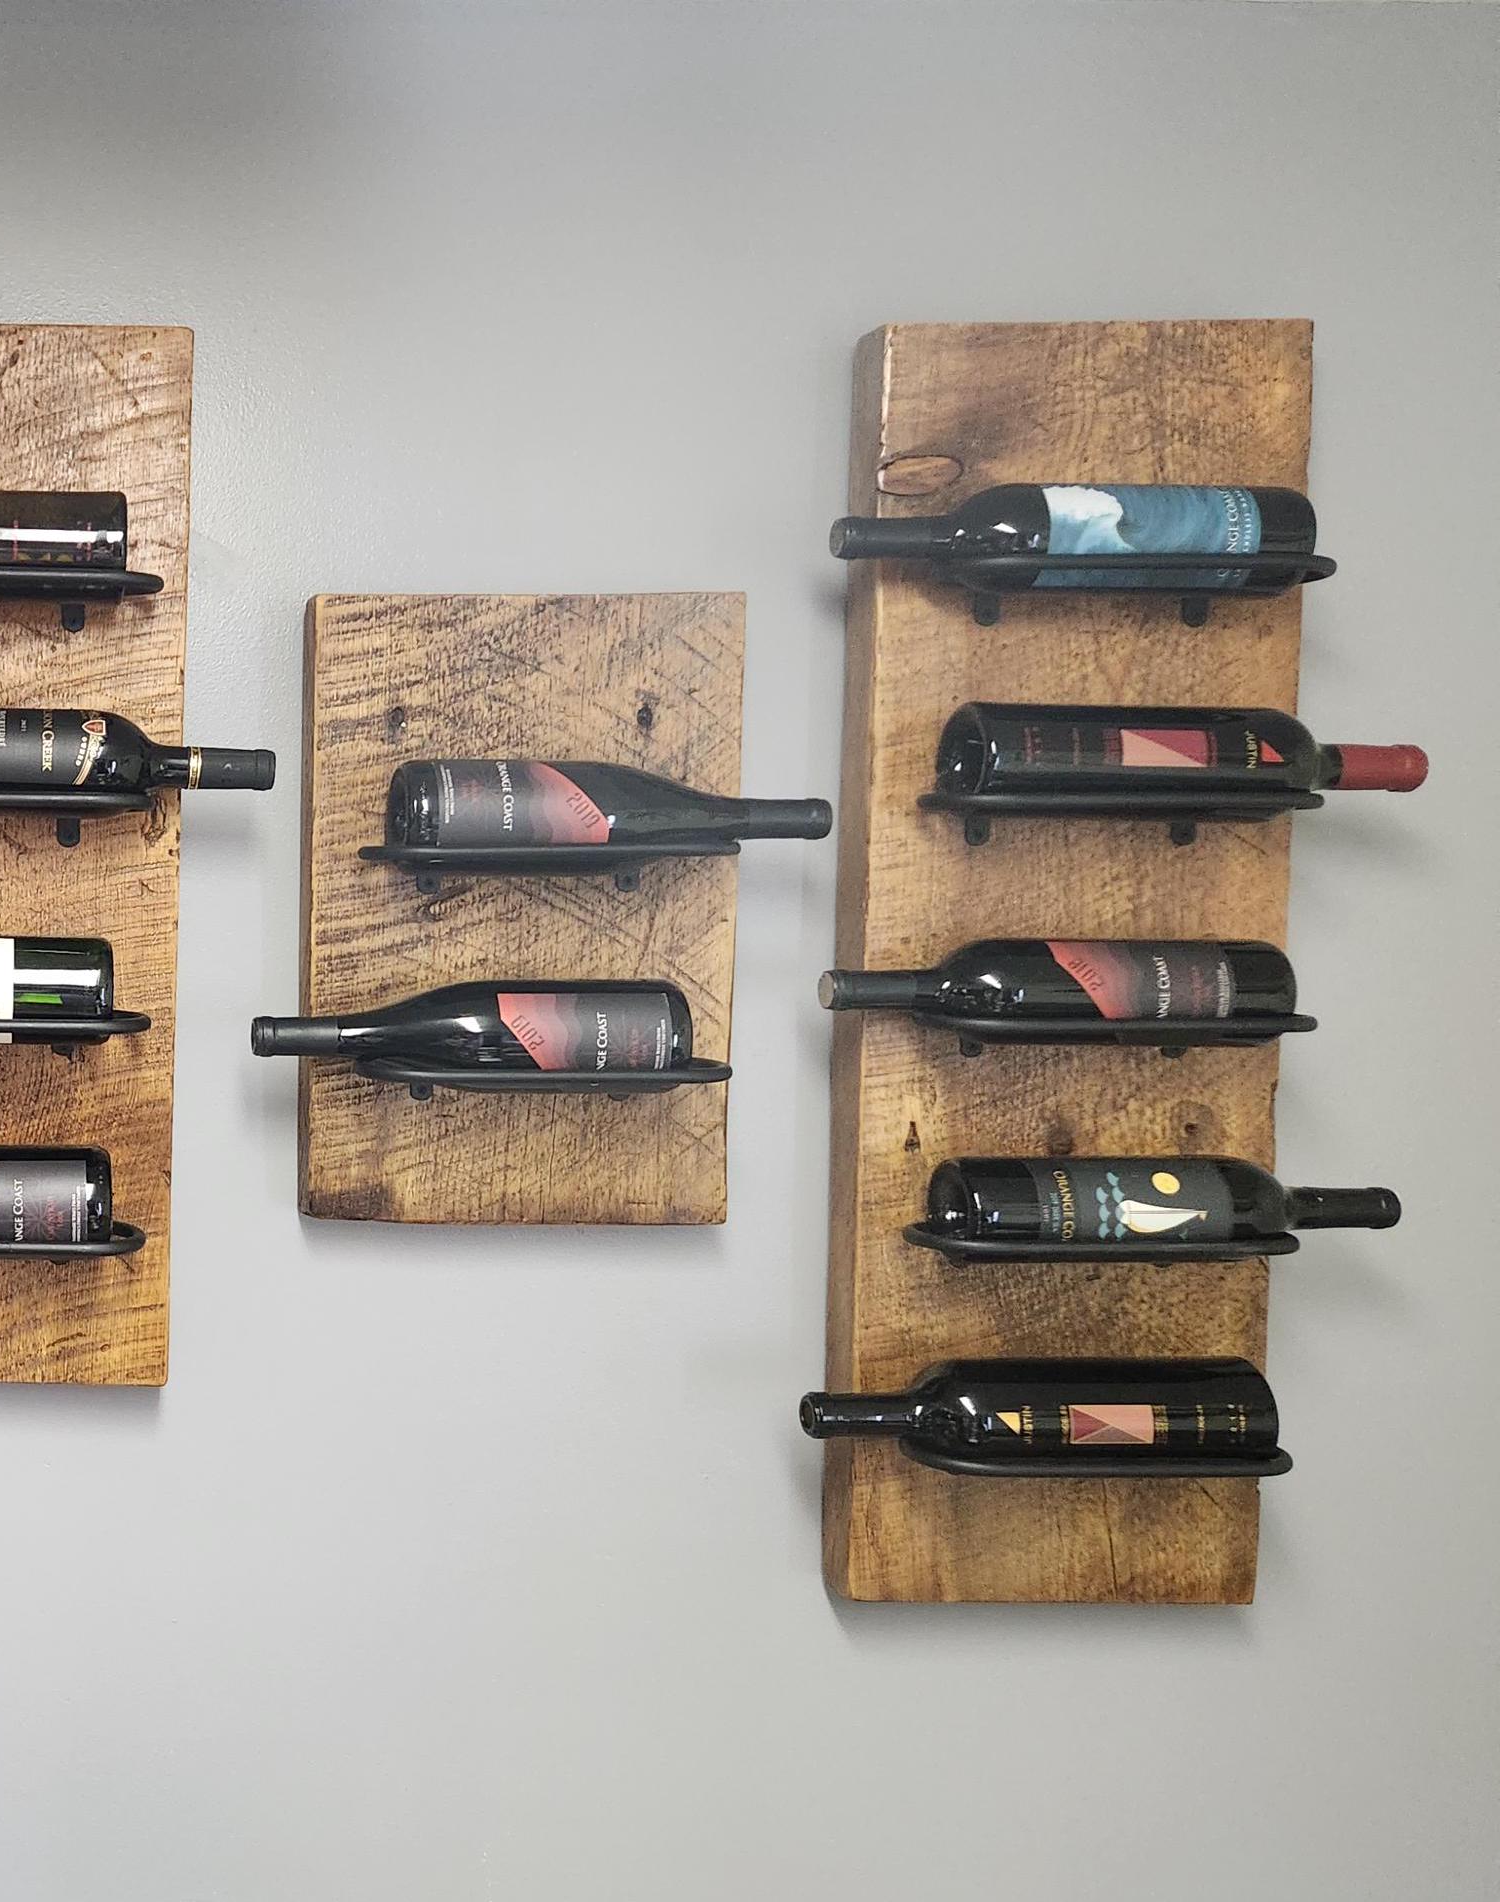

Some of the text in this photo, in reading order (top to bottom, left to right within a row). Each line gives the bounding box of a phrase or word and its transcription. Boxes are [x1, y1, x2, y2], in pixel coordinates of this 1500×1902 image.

[42, 730, 55, 772] CREEK
[1244, 730, 1258, 769] JUSTIN
[495, 761, 514, 832] ORANGE COAST
[566, 792, 600, 829] 2019
[511, 1015, 545, 1050] 2019
[596, 1011, 608, 1048] COAST
[13, 1179, 24, 1215] COAST
[1053, 1171, 1075, 1218] ORANGE
[1022, 1405, 1034, 1444] JUSTIN
